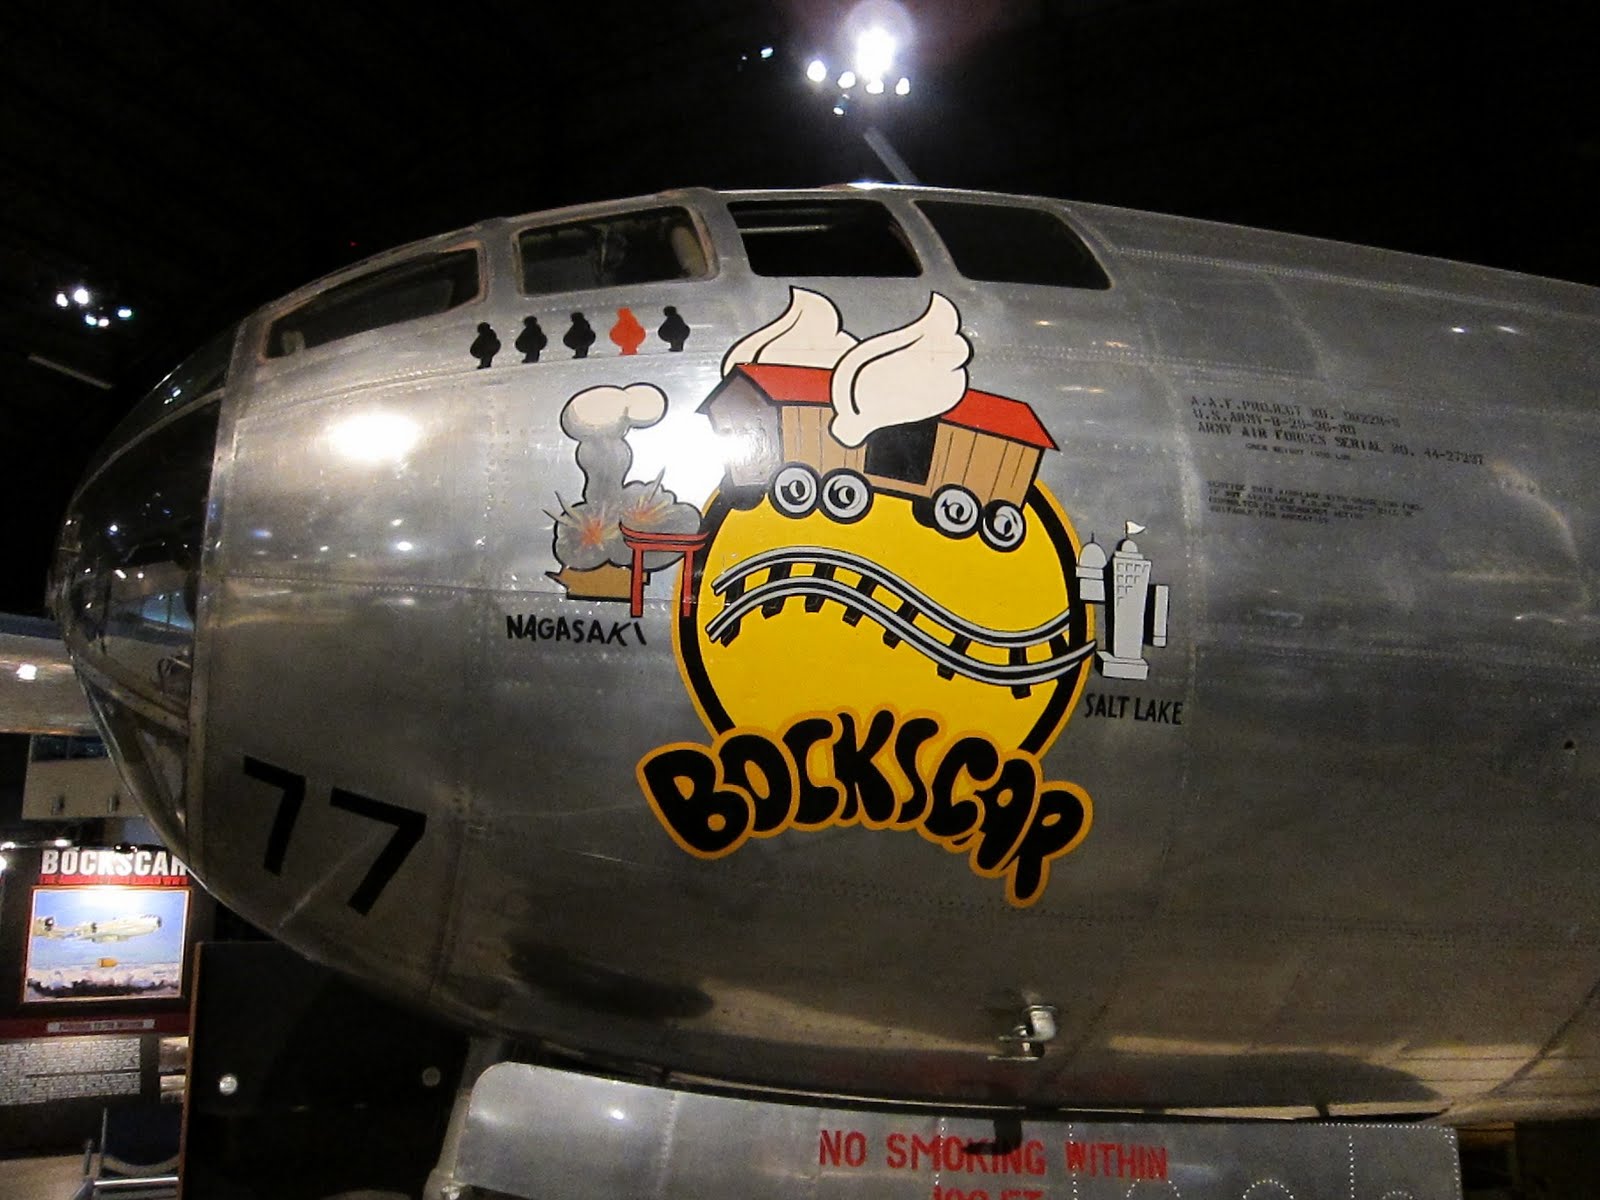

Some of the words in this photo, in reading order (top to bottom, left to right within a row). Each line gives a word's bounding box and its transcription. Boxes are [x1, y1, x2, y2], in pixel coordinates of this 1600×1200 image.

[1198, 421, 1232, 435] ARMY
[1240, 427, 1268, 439] AIR
[1275, 428, 1327, 446] FORCES
[1334, 436, 1384, 453] SERIAL
[1391, 443, 1415, 457] NO.
[506, 614, 647, 646] NAGASAKI
[1084, 693, 1130, 718] SALT
[1134, 697, 1184, 725] LAKE
[638, 706, 1092, 905] BOCKSCAR
[243, 755, 427, 917] 77
[819, 1129, 867, 1168] NO
[886, 1133, 1046, 1176] SMOKING
[1064, 1140, 1169, 1181] WITHIN
